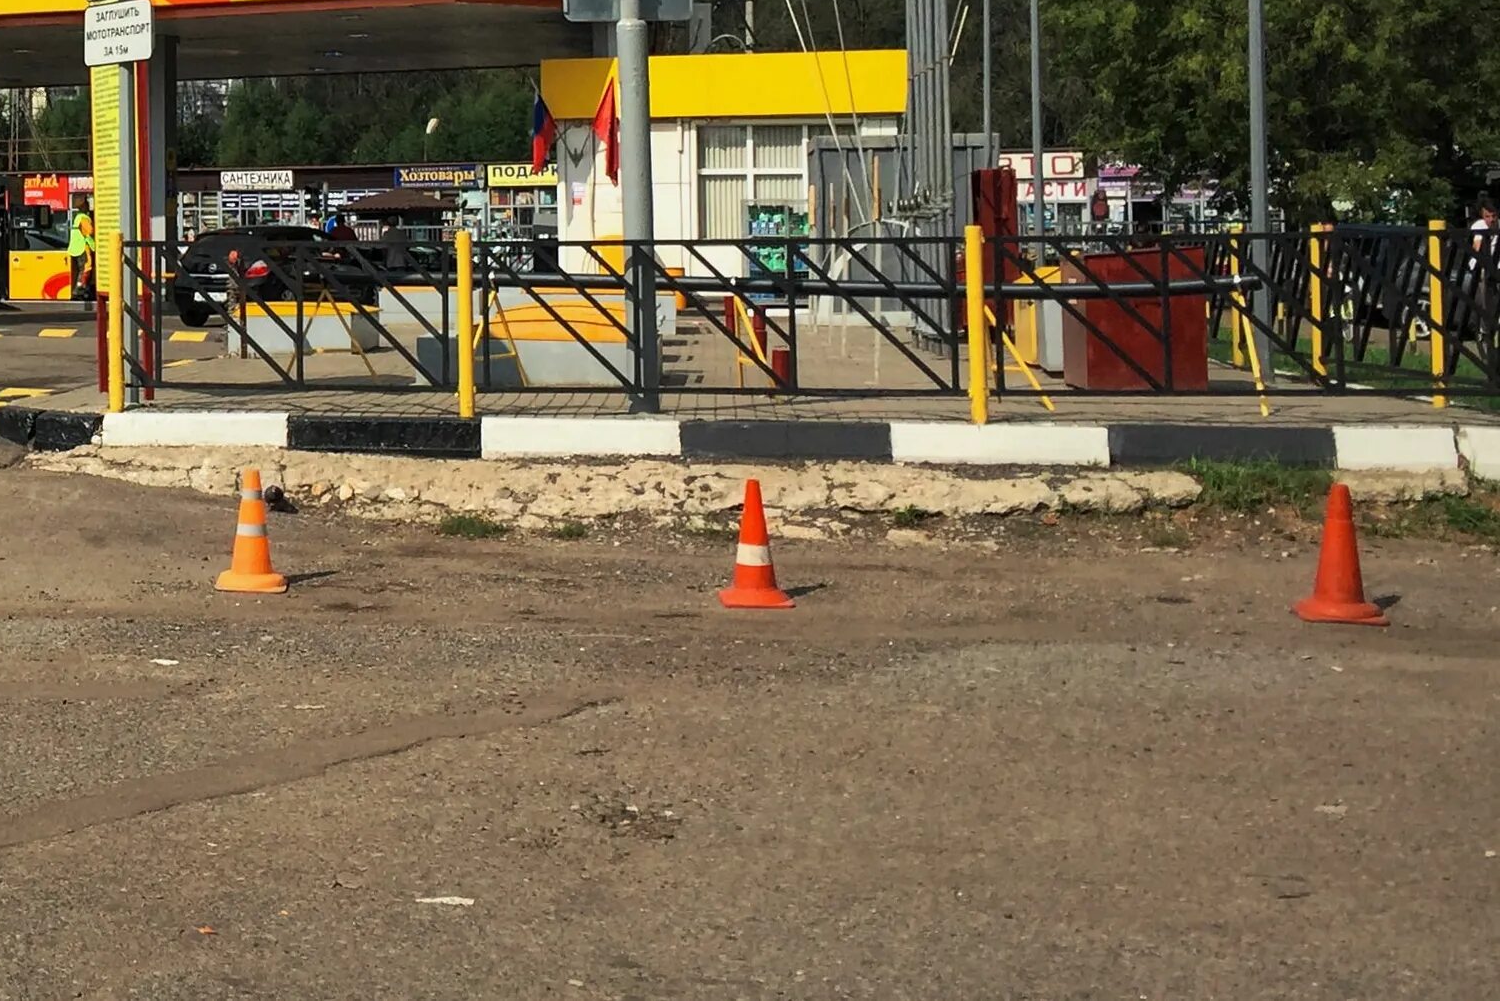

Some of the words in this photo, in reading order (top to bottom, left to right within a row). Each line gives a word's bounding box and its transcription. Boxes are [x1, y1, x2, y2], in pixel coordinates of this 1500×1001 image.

[95, 6, 140, 24] ЗАГЛУШИТЬ
[86, 22, 150, 41] МОТОТРАНСПОРТ
[103, 46, 114, 57] ЗА
[222, 172, 292, 185] САНТЕХНИКА
[399, 168, 476, 187] Хозтовары
[1016, 181, 1087, 197] АСТИ
